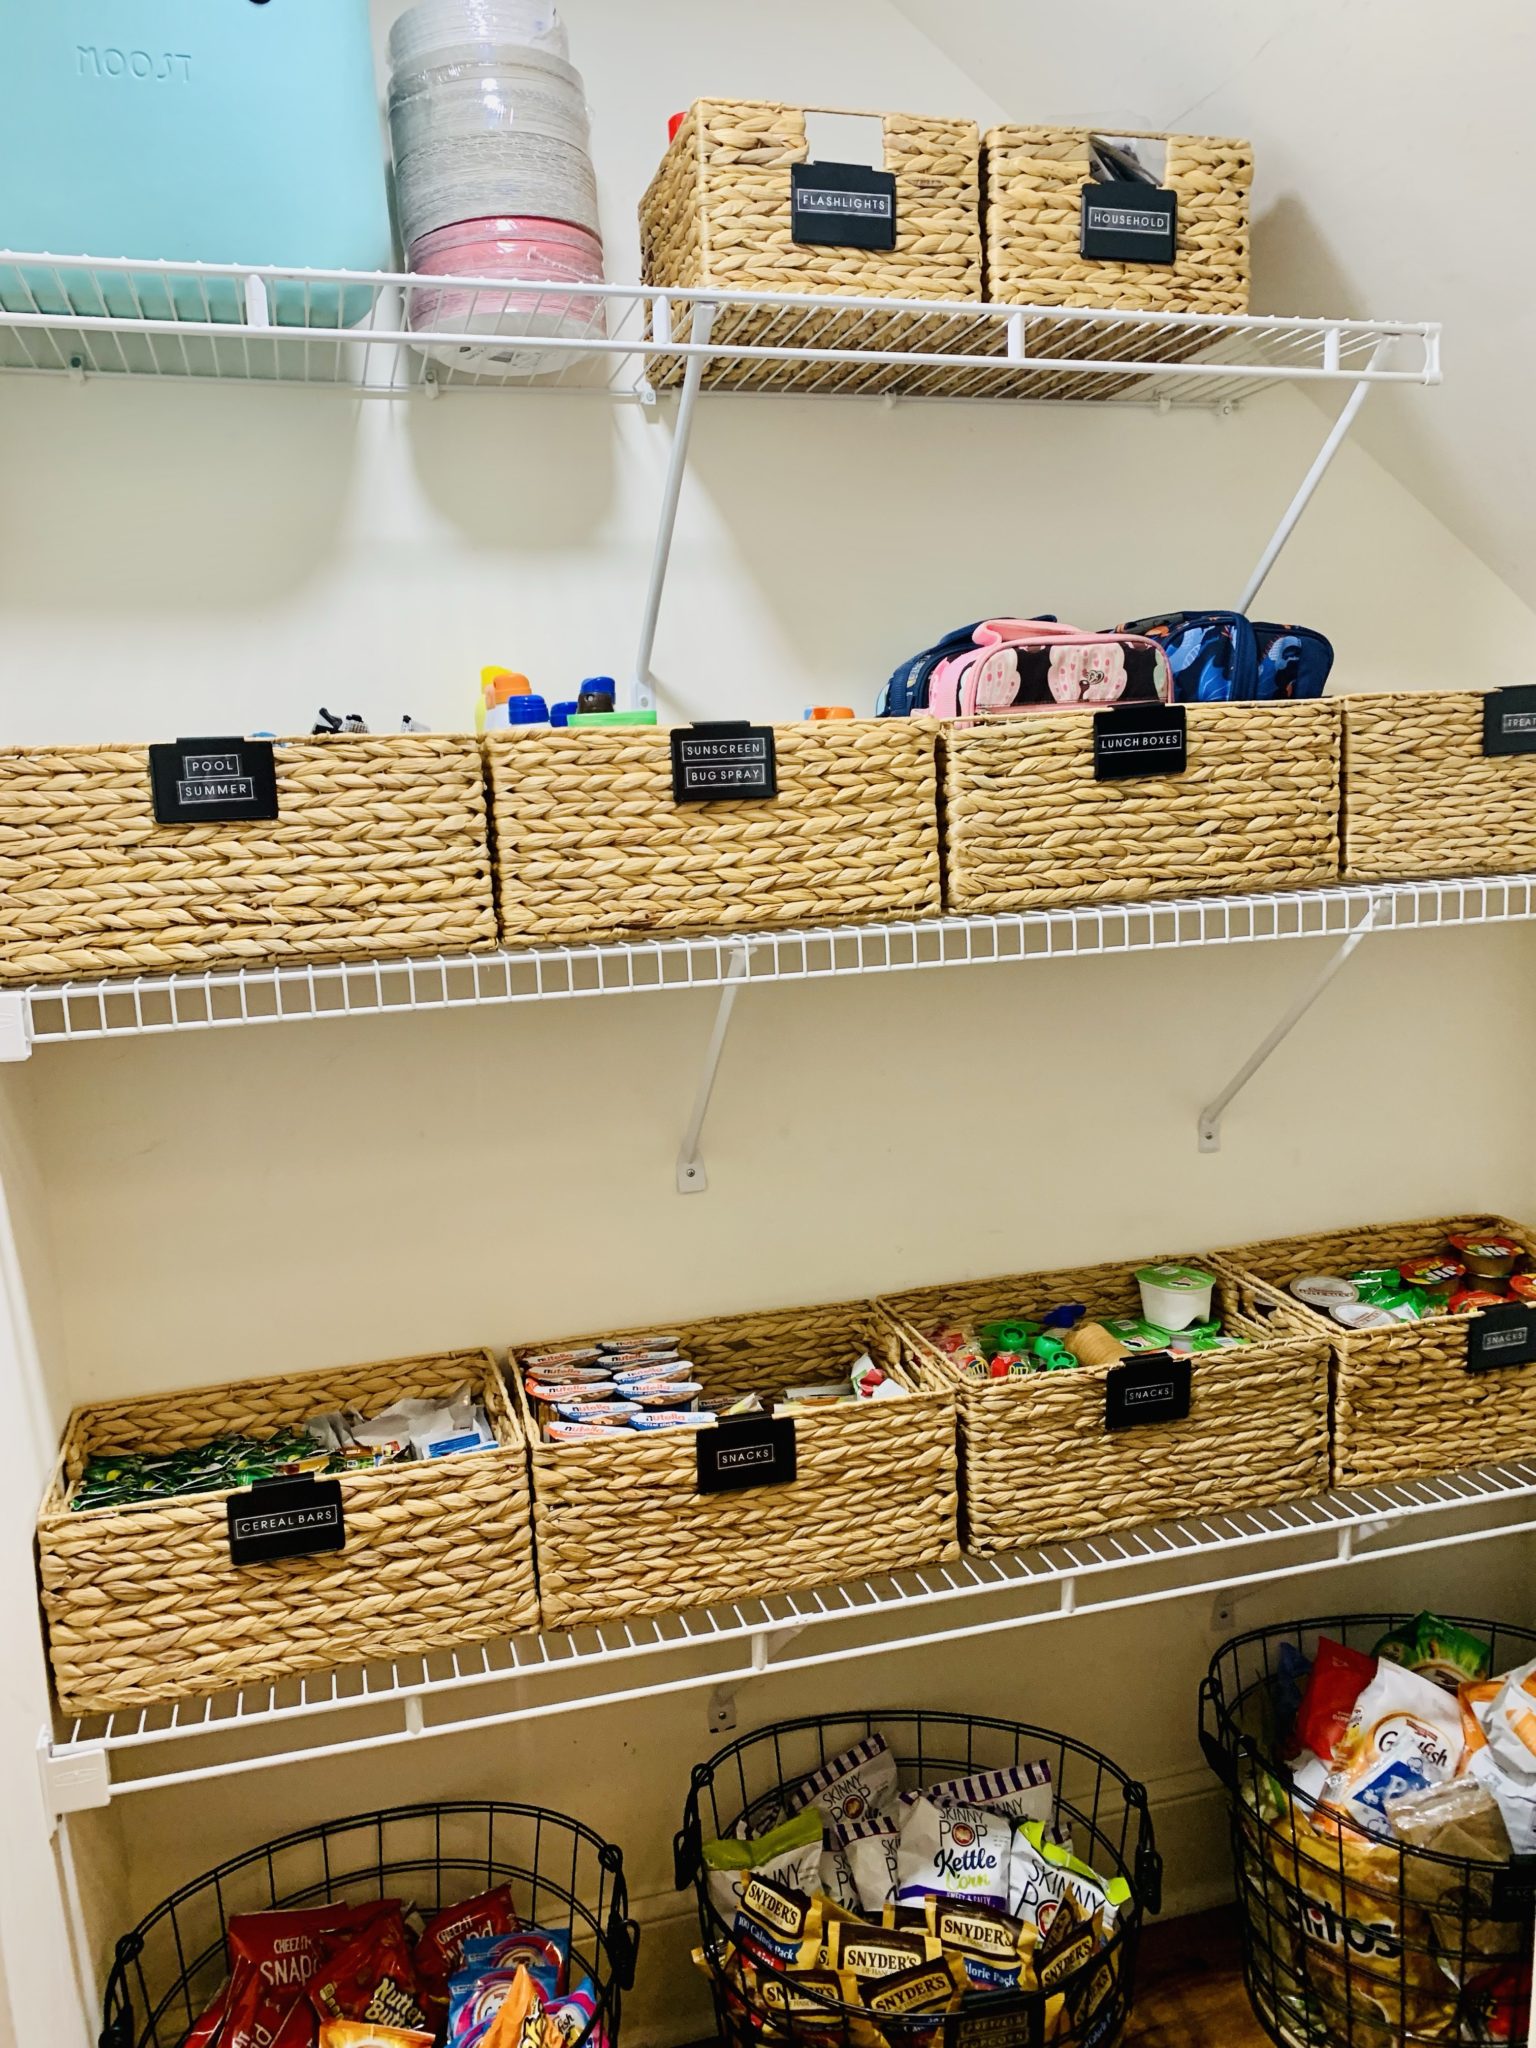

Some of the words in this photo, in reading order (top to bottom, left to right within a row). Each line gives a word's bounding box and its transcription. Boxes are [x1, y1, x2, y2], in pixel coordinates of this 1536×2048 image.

[802, 194, 886, 211] FLASHLIGHTS
[1093, 213, 1165, 228] HOUSEHOLD
[686, 743, 760, 756] SUNSCREEN
[1101, 737, 1139, 749] LUNCH
[1142, 734, 1178, 746] BOXES
[192, 761, 233, 772] POOL
[691, 770, 716, 781] BUG
[720, 769, 760, 780] SPRAY
[185, 783, 247, 797] SUMMER
[1487, 1332, 1522, 1345] SNACKS
[1129, 1387, 1169, 1400] SNACKS
[722, 1449, 769, 1464] SNACKS
[241, 1517, 294, 1532] CEREAL
[298, 1510, 332, 1524] BARS
[823, 1773, 863, 1808] SKINNY
[939, 1807, 983, 1824] SKINNY
[934, 1848, 997, 1878] Kettle
[946, 1872, 990, 1891] Corn
[748, 1884, 798, 1926] SNYDER'S
[944, 1919, 1014, 1947] SNYDER'S
[774, 1945, 794, 1960] Pack
[848, 1949, 917, 1970] SNYDER'S
[373, 1977, 426, 2025] Nutter
[875, 1976, 946, 2012] SNYDER'S
[365, 1998, 411, 2029] Butt
